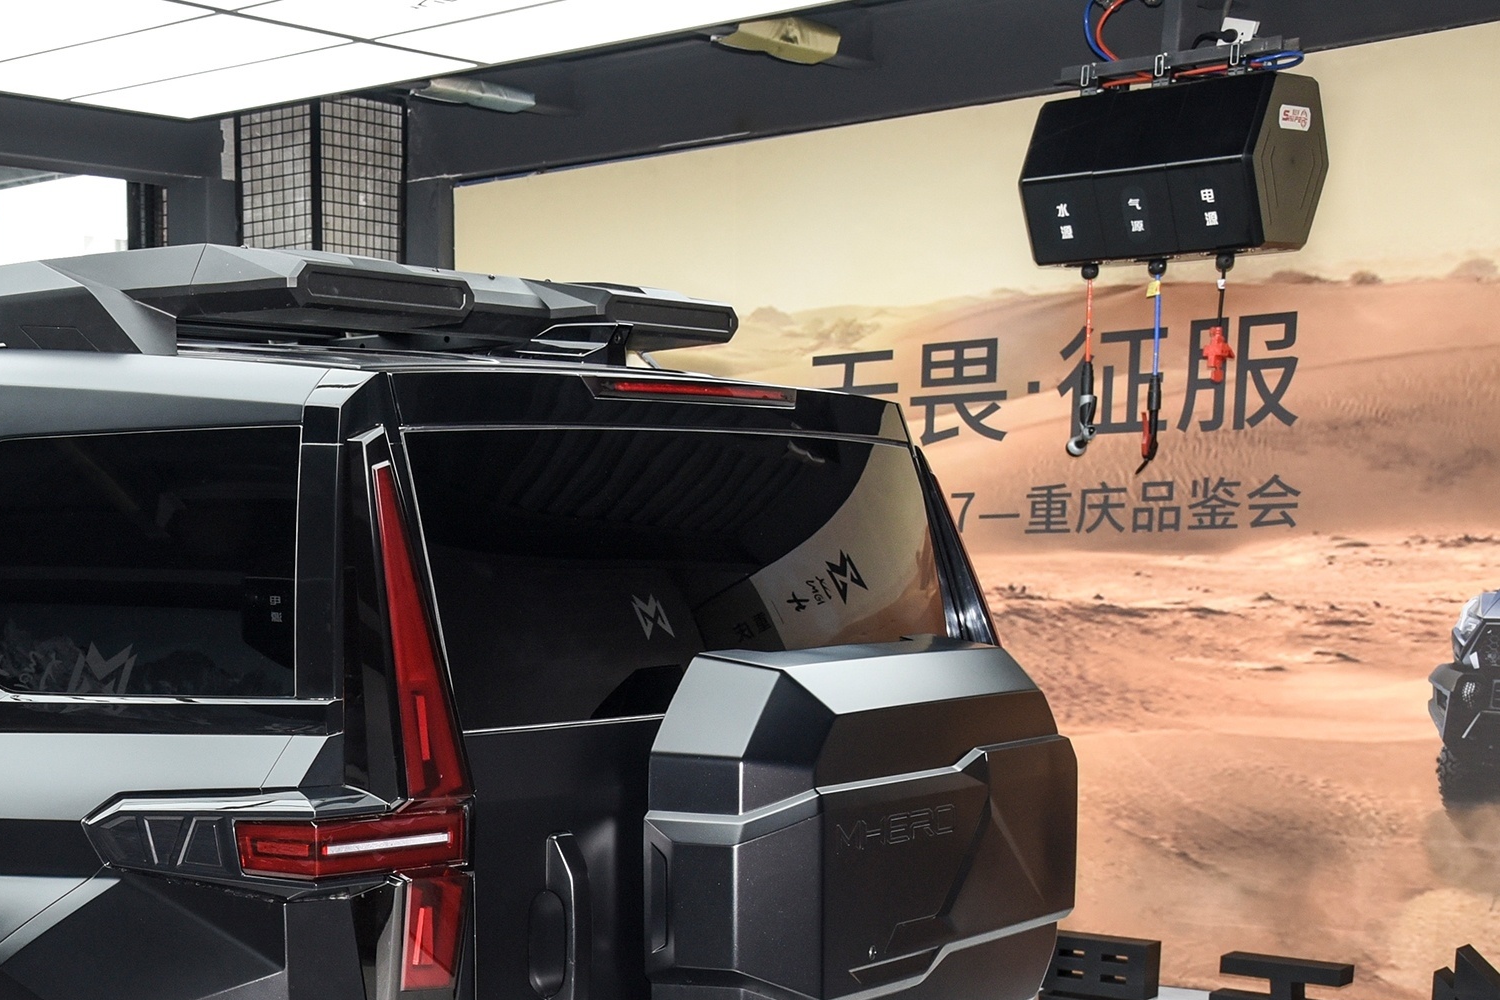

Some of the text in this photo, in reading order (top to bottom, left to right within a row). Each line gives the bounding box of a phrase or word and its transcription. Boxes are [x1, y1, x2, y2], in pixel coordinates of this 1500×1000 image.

[1056, 203, 1074, 239] 水源
[1128, 198, 1145, 232] 气源
[1200, 188, 1219, 226] 电源
[835, 803, 956, 855] MHERO
